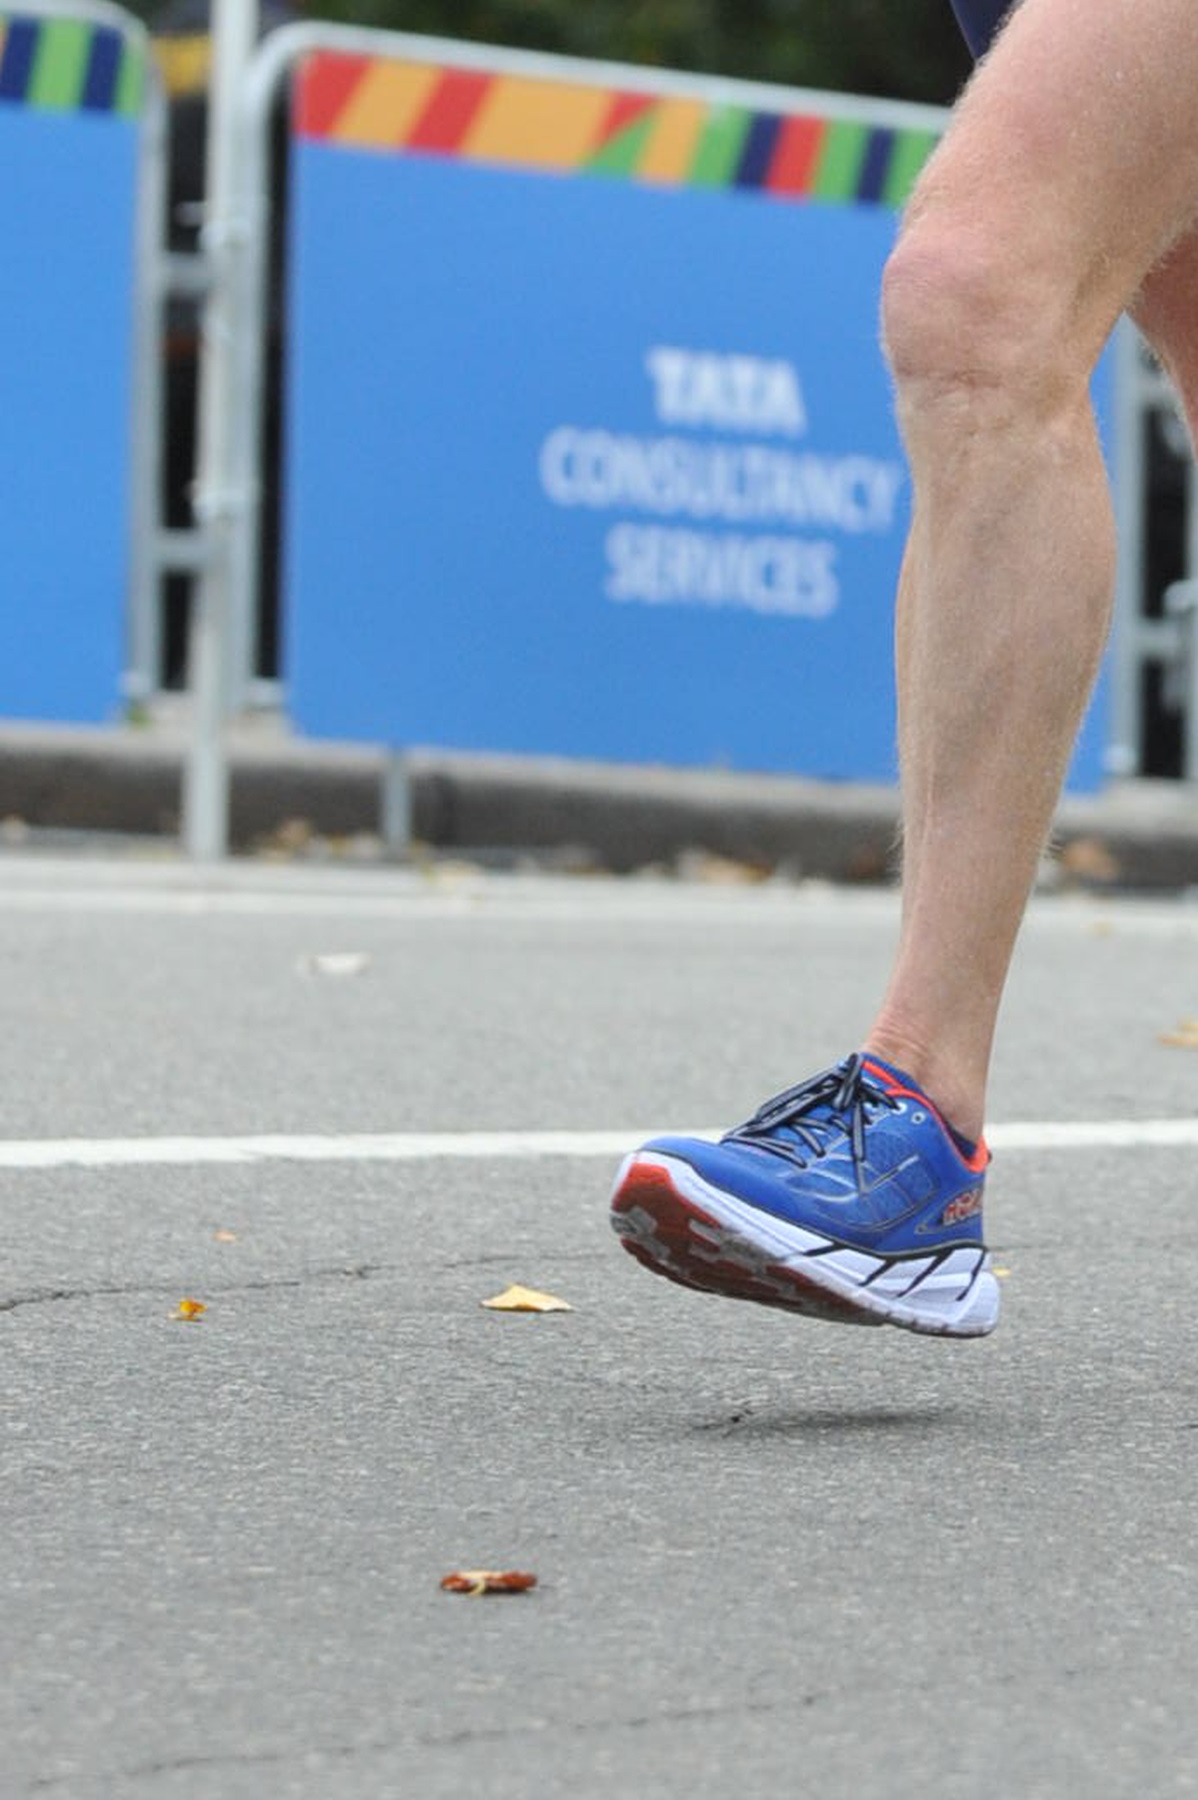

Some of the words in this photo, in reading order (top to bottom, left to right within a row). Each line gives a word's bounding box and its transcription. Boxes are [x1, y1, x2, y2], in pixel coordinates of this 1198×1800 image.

[646, 347, 806, 438] TATA
[540, 427, 898, 532] CONSULTANCY
[606, 522, 838, 617] SERVICES
